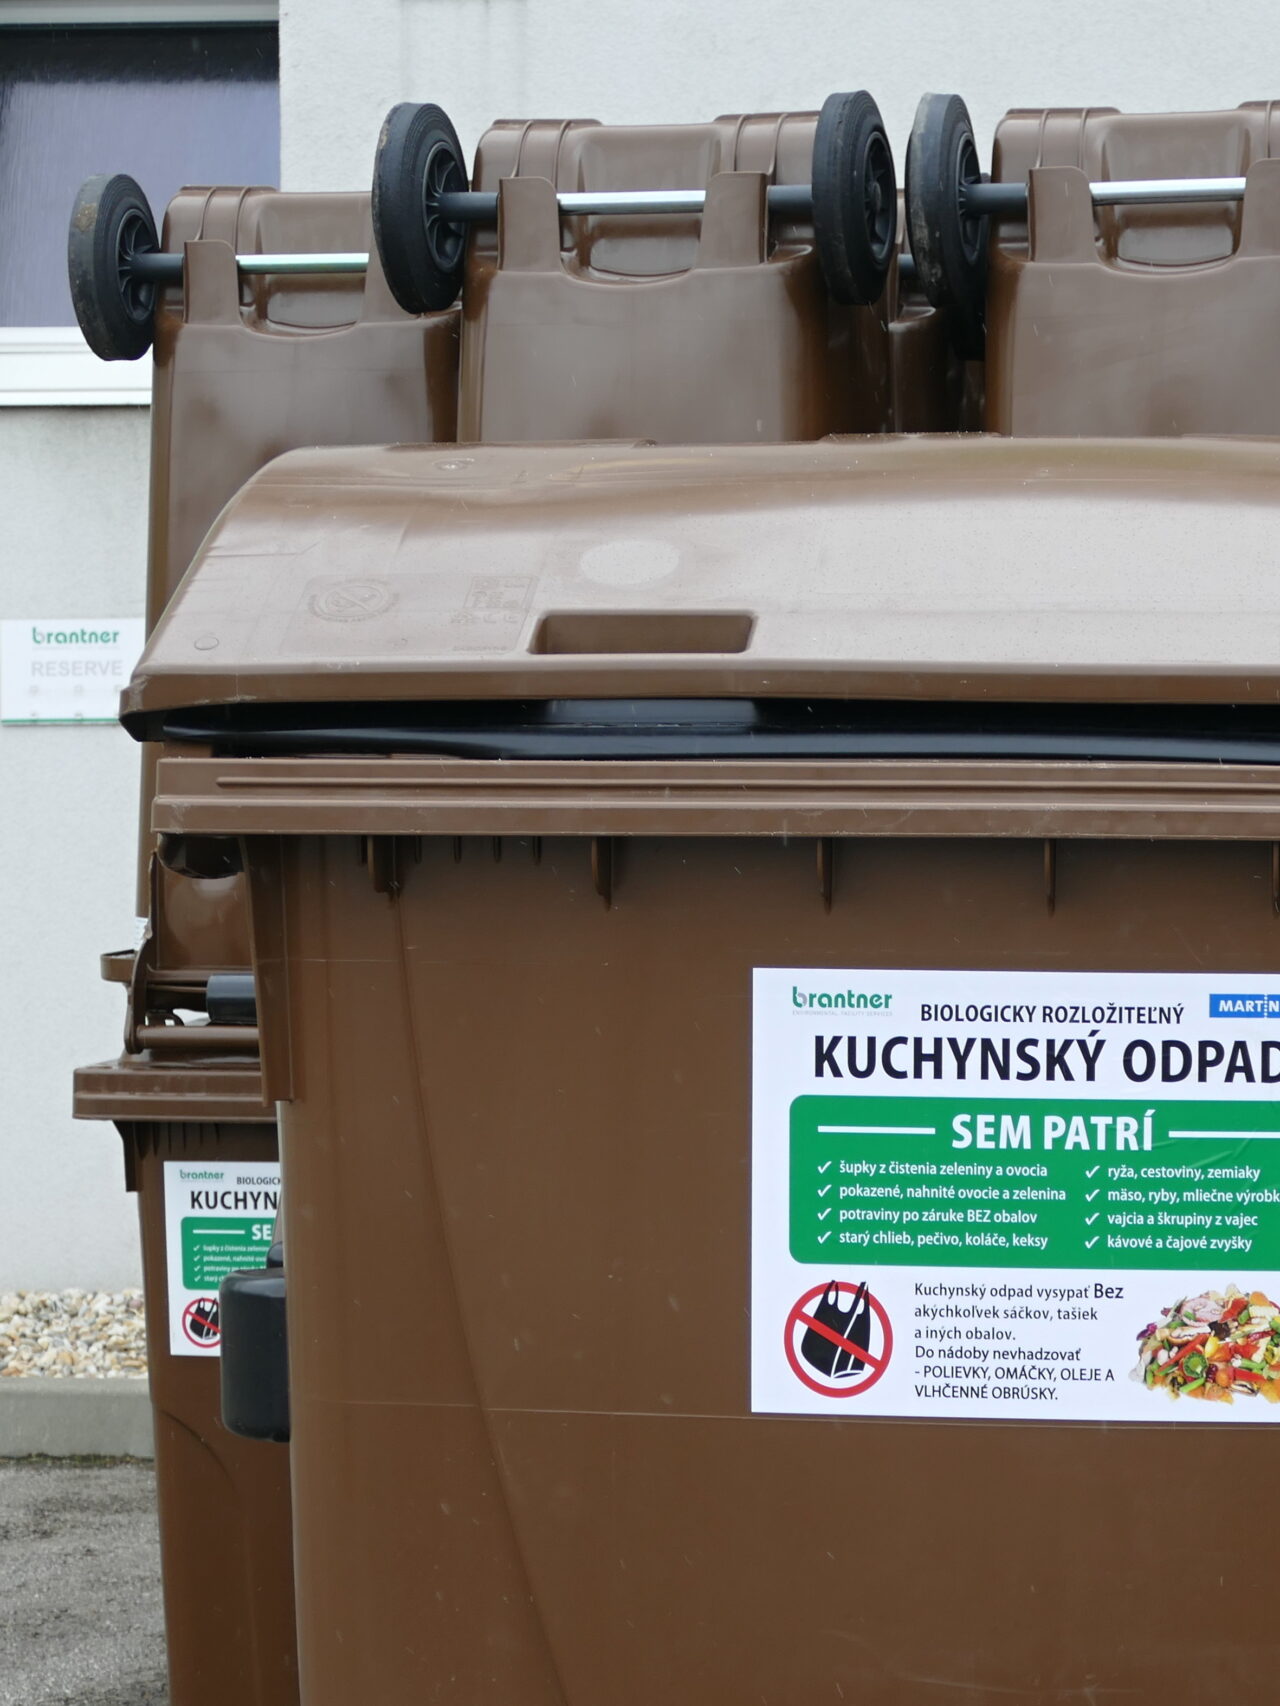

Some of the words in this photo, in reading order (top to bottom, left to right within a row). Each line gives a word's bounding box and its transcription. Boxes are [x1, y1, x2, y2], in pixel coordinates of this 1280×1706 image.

[32, 627, 120, 644] brantner
[31, 660, 123, 677] RESERVE
[792, 986, 893, 1009] brantner
[921, 1003, 1037, 1022] BIOLOGICKY
[1042, 1002, 1184, 1024] ROZLOŽITEĽNÝ
[814, 1031, 1106, 1082] KUCHYNSKÝ
[951, 1113, 1032, 1149] SEM
[1043, 1109, 1156, 1151] PATRÍ
[839, 1159, 877, 1176] šupky
[878, 1163, 886, 1174] z
[888, 1160, 937, 1175] čistenia
[939, 1161, 993, 1179] zeleniny
[995, 1165, 1003, 1176] a
[1005, 1163, 1048, 1176] ovocia
[1108, 1164, 1138, 1180] ryža,
[1140, 1165, 1205, 1181] cestoviny,
[1206, 1165, 1261, 1182] zemiaky
[237, 1177, 280, 1185] BIOLOGIC
[191, 1190, 277, 1210] KUCHYN
[839, 1183, 904, 1199] pokazené,
[906, 1184, 955, 1199] nahnité
[957, 1186, 1000, 1199] ovocie
[1002, 1189, 1010, 1199] a
[1012, 1186, 1066, 1200] zelenina
[1107, 1188, 1146, 1203] mäso,
[1148, 1188, 1180, 1204] ryby,
[1182, 1188, 1234, 1202] mliečne
[839, 1207, 900, 1224] potraviny
[902, 1210, 919, 1224] po
[921, 1208, 964, 1222] záruke
[966, 1209, 991, 1222] BEZ
[993, 1209, 1038, 1223] obalov
[1107, 1211, 1145, 1227] vajcia
[1146, 1214, 1155, 1225] a
[1157, 1211, 1213, 1228] škrupiny
[1214, 1215, 1223, 1225] z
[1224, 1212, 1258, 1229] vajec
[251, 1224, 272, 1241] SE
[839, 1230, 870, 1246] starý
[872, 1230, 915, 1246] chlieb,
[917, 1231, 962, 1247] pečivo,
[965, 1232, 1009, 1248] koláče,
[1012, 1232, 1048, 1250] keksy
[1107, 1234, 1153, 1248] kávové
[1155, 1238, 1163, 1248] a
[1165, 1235, 1208, 1251] čajové
[1209, 1235, 1253, 1252] zvyšky
[915, 1283, 987, 1300] Kuchynský
[990, 1284, 1033, 1300] odpad
[1036, 1285, 1090, 1301] vysypať
[1094, 1283, 1124, 1299] Bez
[914, 1304, 1000, 1320] akýchkoľvek
[1003, 1306, 1053, 1321] sáčkov,
[1057, 1307, 1098, 1320] tašiek
[914, 1329, 922, 1338] a
[925, 1326, 962, 1342] iných
[965, 1326, 1016, 1340] obalov.
[915, 1345, 934, 1358] Do
[938, 1345, 989, 1362] nádoby
[993, 1346, 1081, 1361] nevhadzovať
[923, 1365, 991, 1381] POLIEVKY,
[994, 1364, 1057, 1382] OMÁČKY,
[1060, 1367, 1101, 1381] OLEJE
[1105, 1368, 1115, 1381] A
[914, 1383, 988, 1399] VLHČENNÉ
[991, 1384, 1058, 1400] OBRÚSKY.
